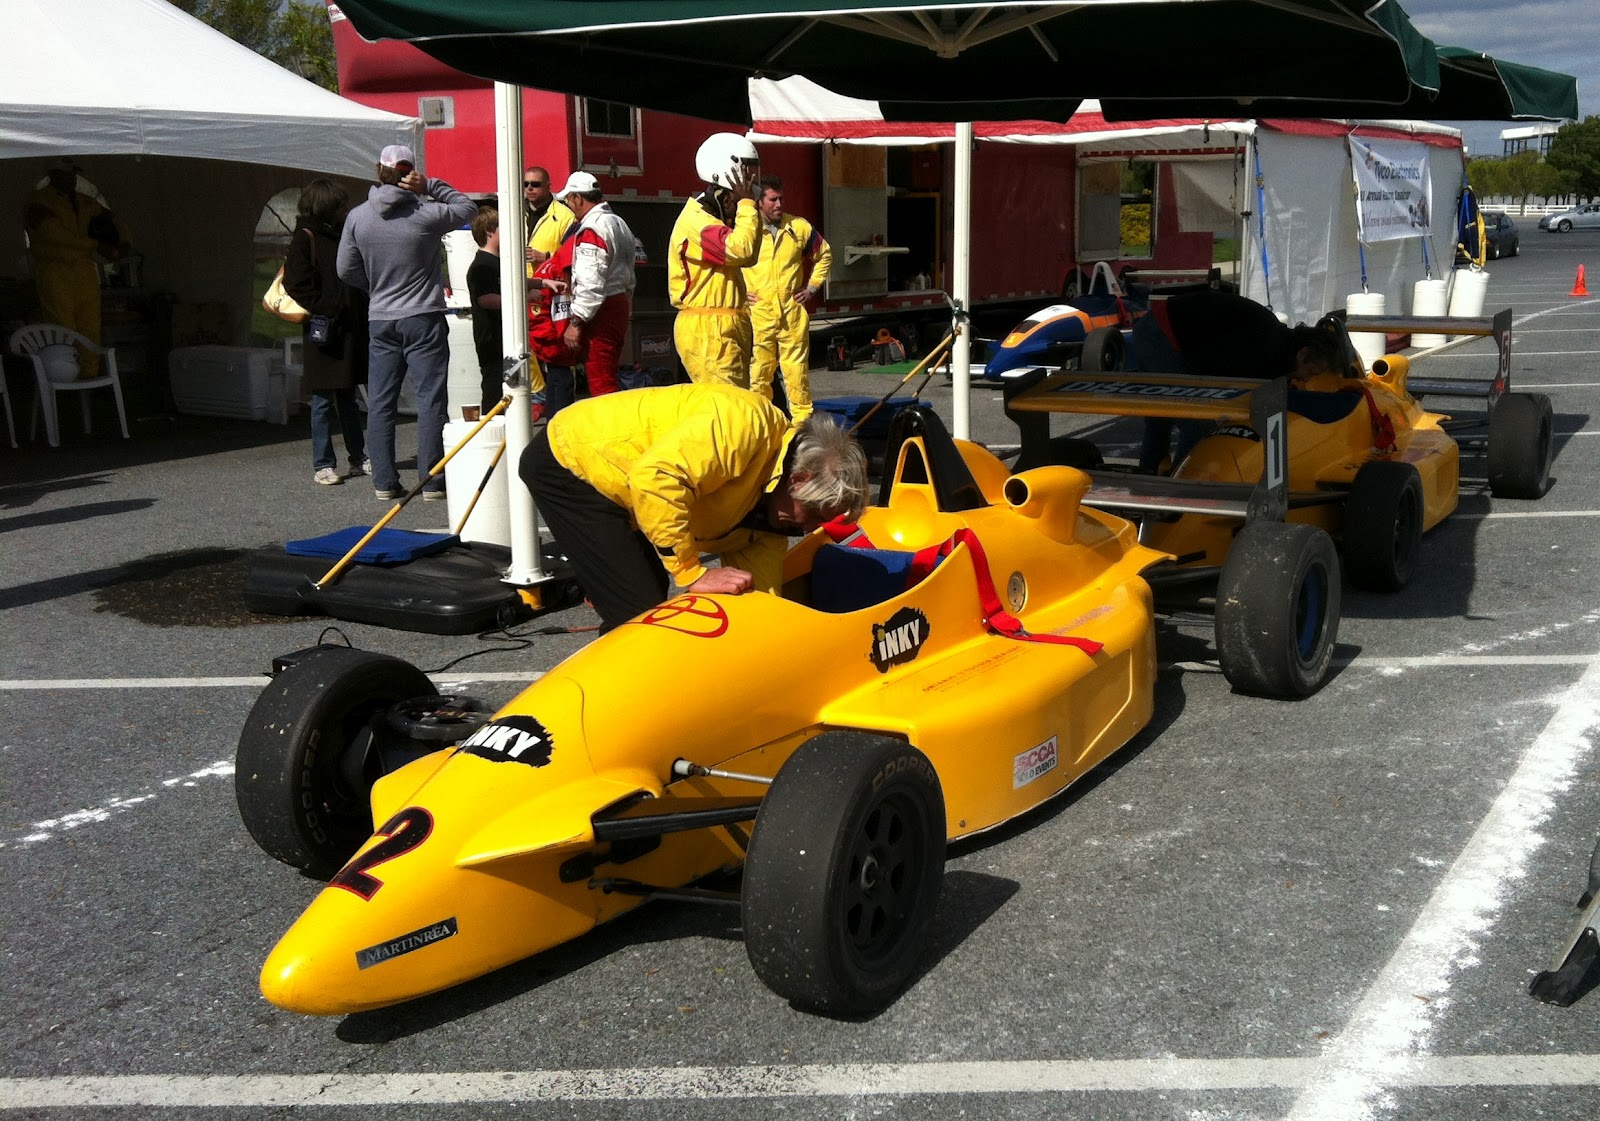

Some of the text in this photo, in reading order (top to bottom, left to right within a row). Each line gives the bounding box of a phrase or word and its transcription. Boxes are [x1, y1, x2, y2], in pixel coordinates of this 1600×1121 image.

[1374, 161, 1391, 183] Tyco
[1270, 419, 1280, 482] 1
[460, 725, 541, 758] NKY
[326, 806, 434, 902] 2
